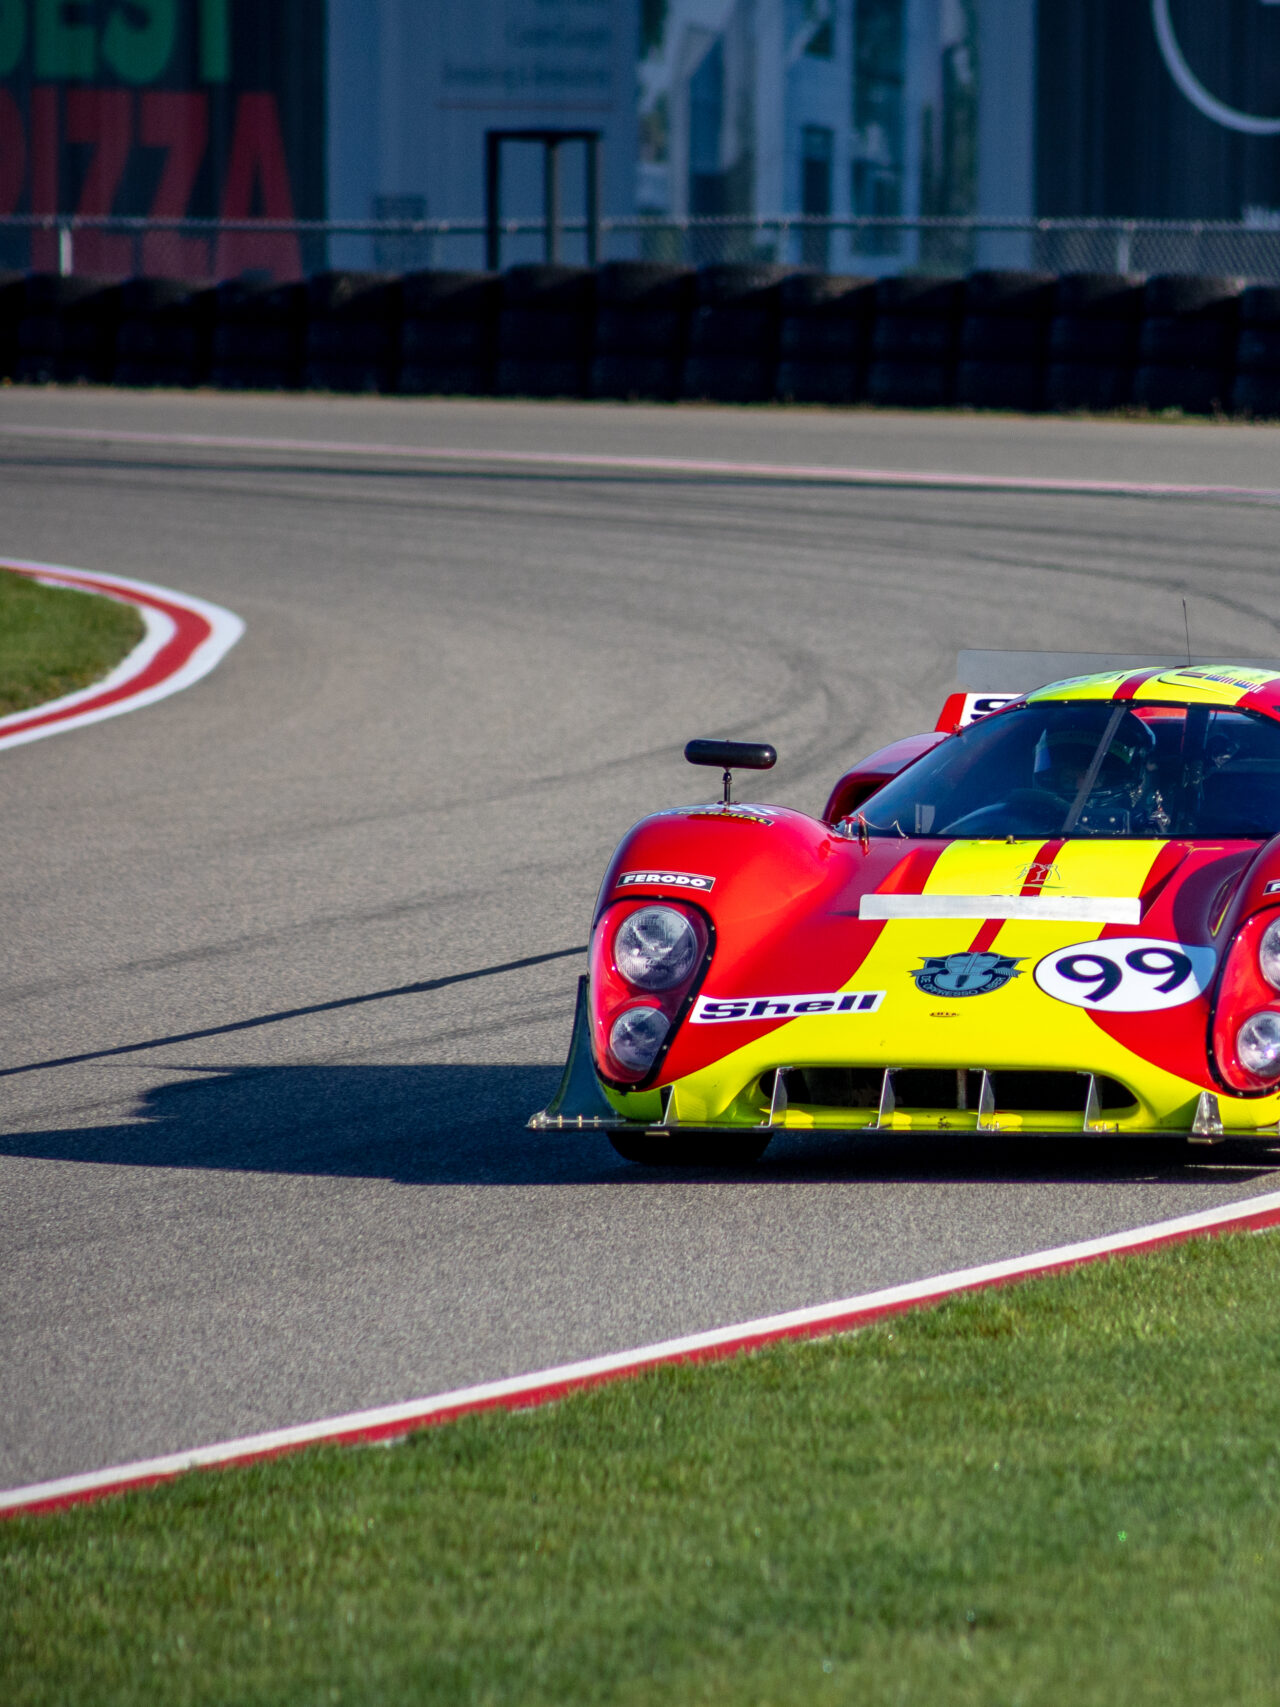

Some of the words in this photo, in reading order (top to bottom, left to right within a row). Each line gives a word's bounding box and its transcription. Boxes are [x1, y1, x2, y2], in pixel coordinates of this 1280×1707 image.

[623, 873, 708, 888] FERODO
[1055, 947, 1193, 1003] 99
[700, 993, 878, 1020] Shell
